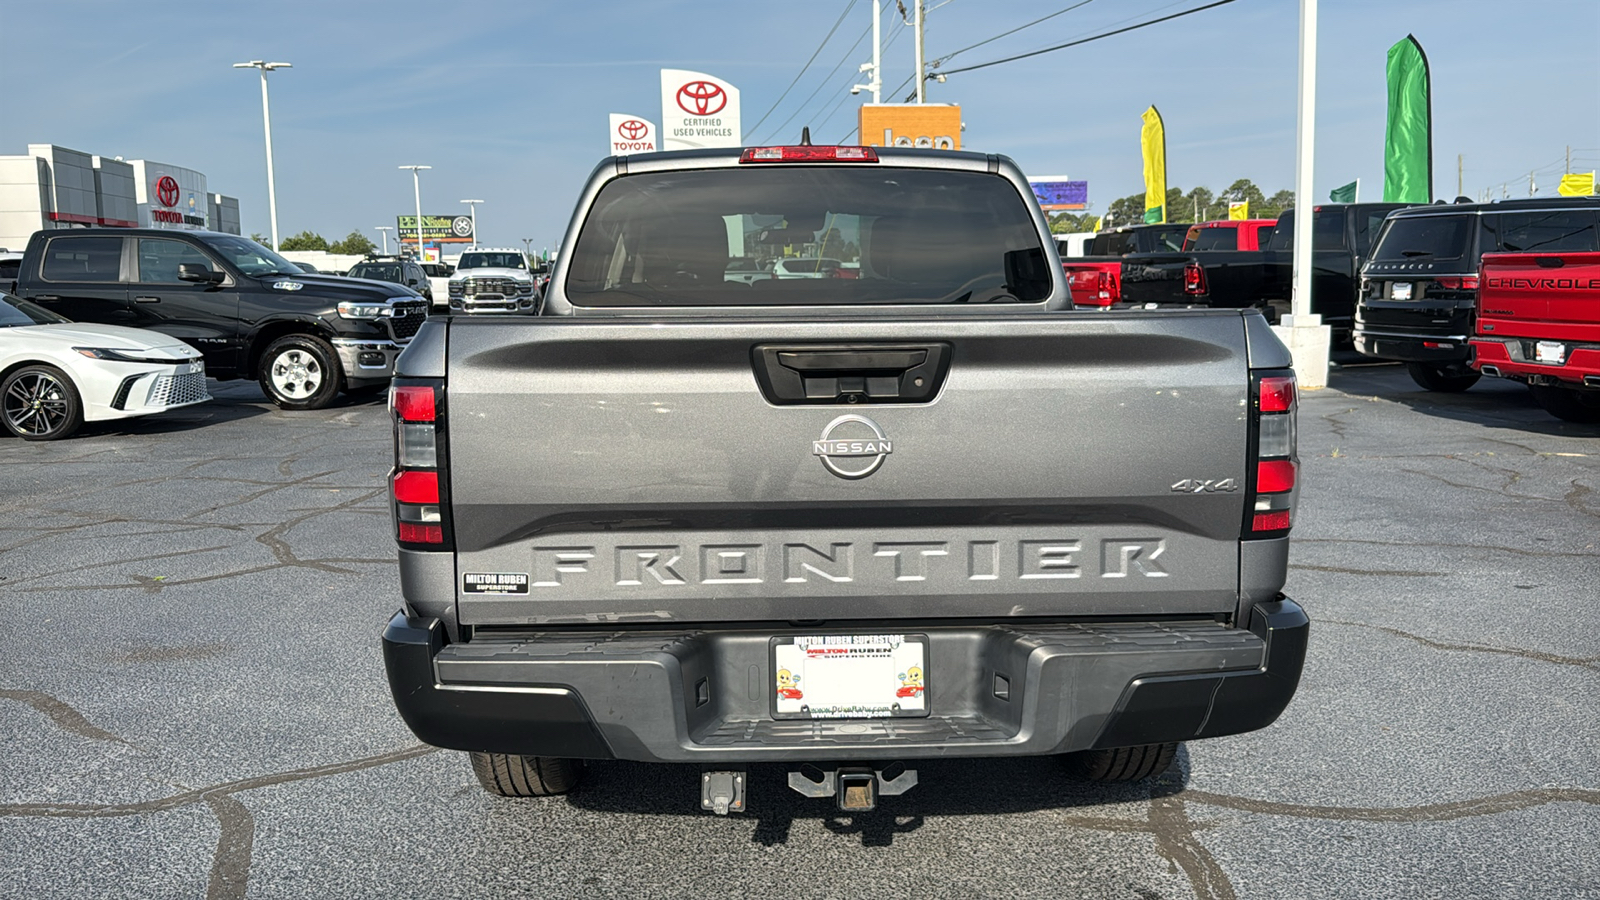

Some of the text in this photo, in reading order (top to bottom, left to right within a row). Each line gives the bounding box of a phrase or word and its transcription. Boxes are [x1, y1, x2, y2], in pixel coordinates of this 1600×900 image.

[683, 118, 722, 126] CERTIFIED
[673, 128, 732, 137] USED VEHICLES
[613, 142, 654, 151] TOYOTA
[152, 209, 184, 224] TOYOTA
[1488, 278, 1600, 289] CHEVROLE
[814, 442, 892, 453] NISSAN
[532, 539, 1169, 587] FRONTIER
[466, 574, 527, 585] MILTON RUBEN
[794, 635, 905, 645] MILTON RUBEN SUPERSTORE
